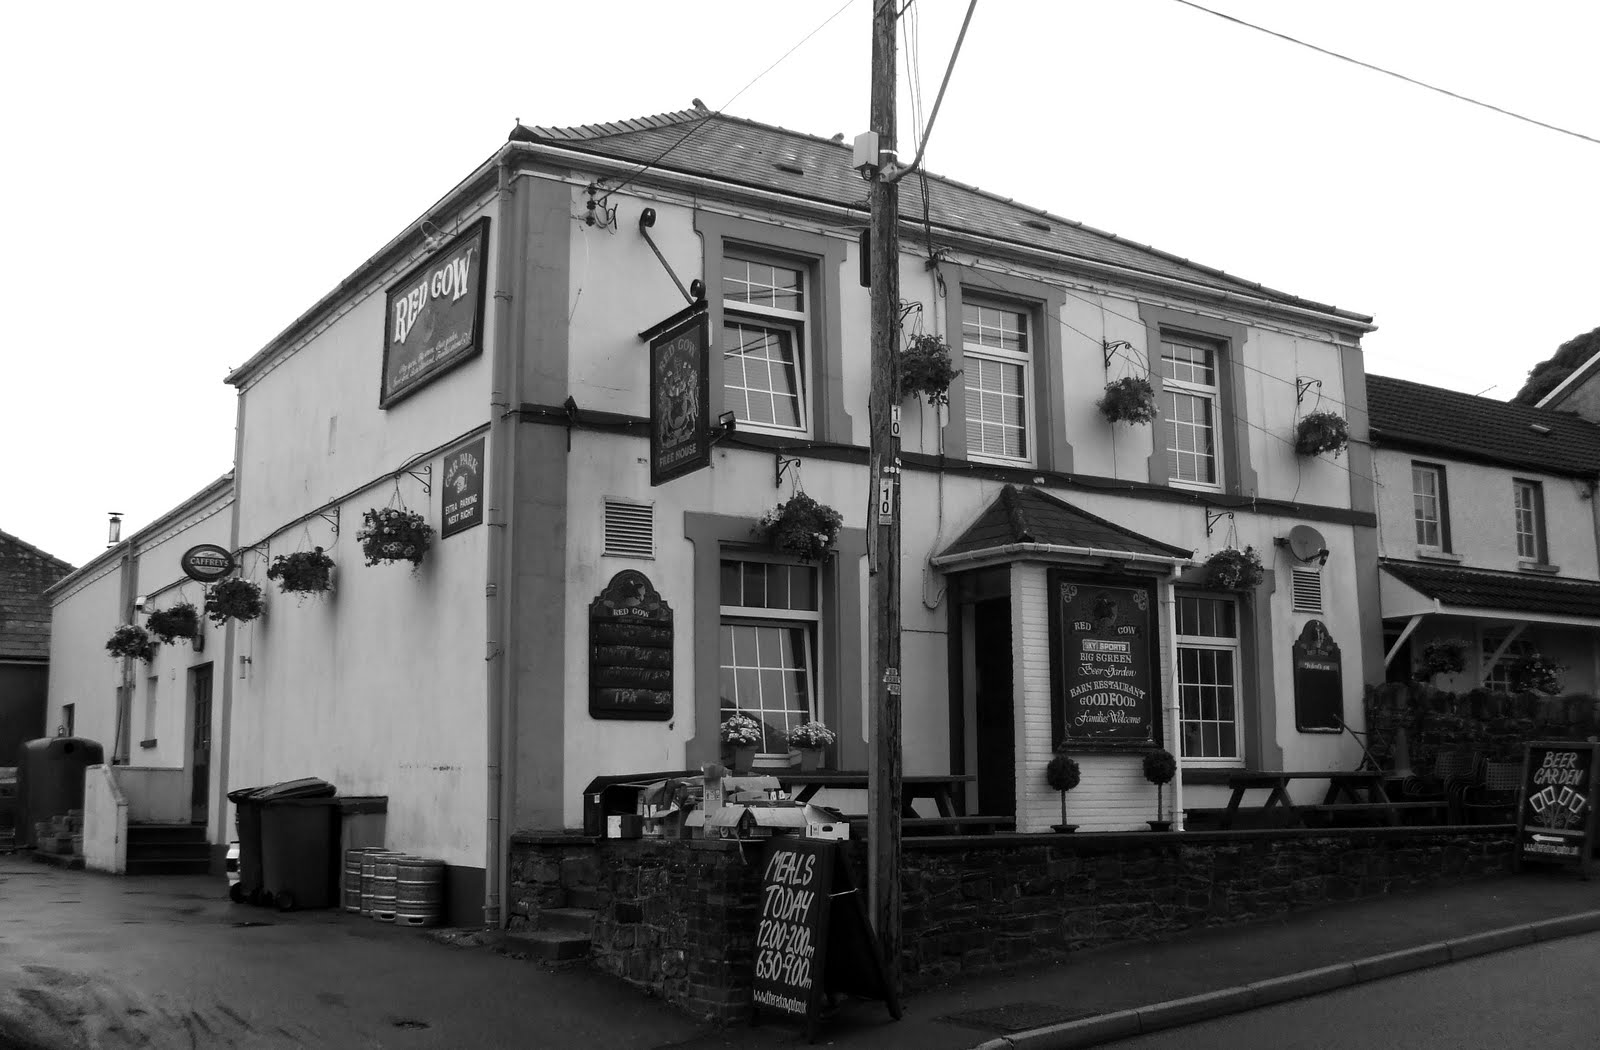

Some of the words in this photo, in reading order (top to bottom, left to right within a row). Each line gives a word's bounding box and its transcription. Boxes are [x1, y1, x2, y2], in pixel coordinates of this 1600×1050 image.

[394, 280, 428, 344] RED
[431, 247, 473, 302] COW
[659, 452, 674, 467] FREE
[675, 443, 697, 460] HOUSE
[445, 460, 458, 487] CAR
[460, 452, 479, 475] PARK
[460, 493, 478, 509] PARKING
[613, 608, 629, 616] RED
[632, 607, 649, 618] COW
[1074, 621, 1092, 631] RED
[1117, 625, 1136, 635] COW
[1099, 643, 1126, 652] SPORTS
[1080, 652, 1094, 662] BIG
[1096, 653, 1132, 664] SCREEN
[1078, 663, 1104, 676] Beer
[1103, 664, 1136, 678] Garden
[1069, 681, 1093, 698] BARN
[1093, 680, 1146, 699] RESTAURANT
[1107, 709, 1141, 724] Welcome
[1542, 751, 1578, 768] BEER
[1533, 767, 1584, 785] GARDEN
[764, 850, 816, 886] MEALS
[763, 884, 815, 923] TODAY
